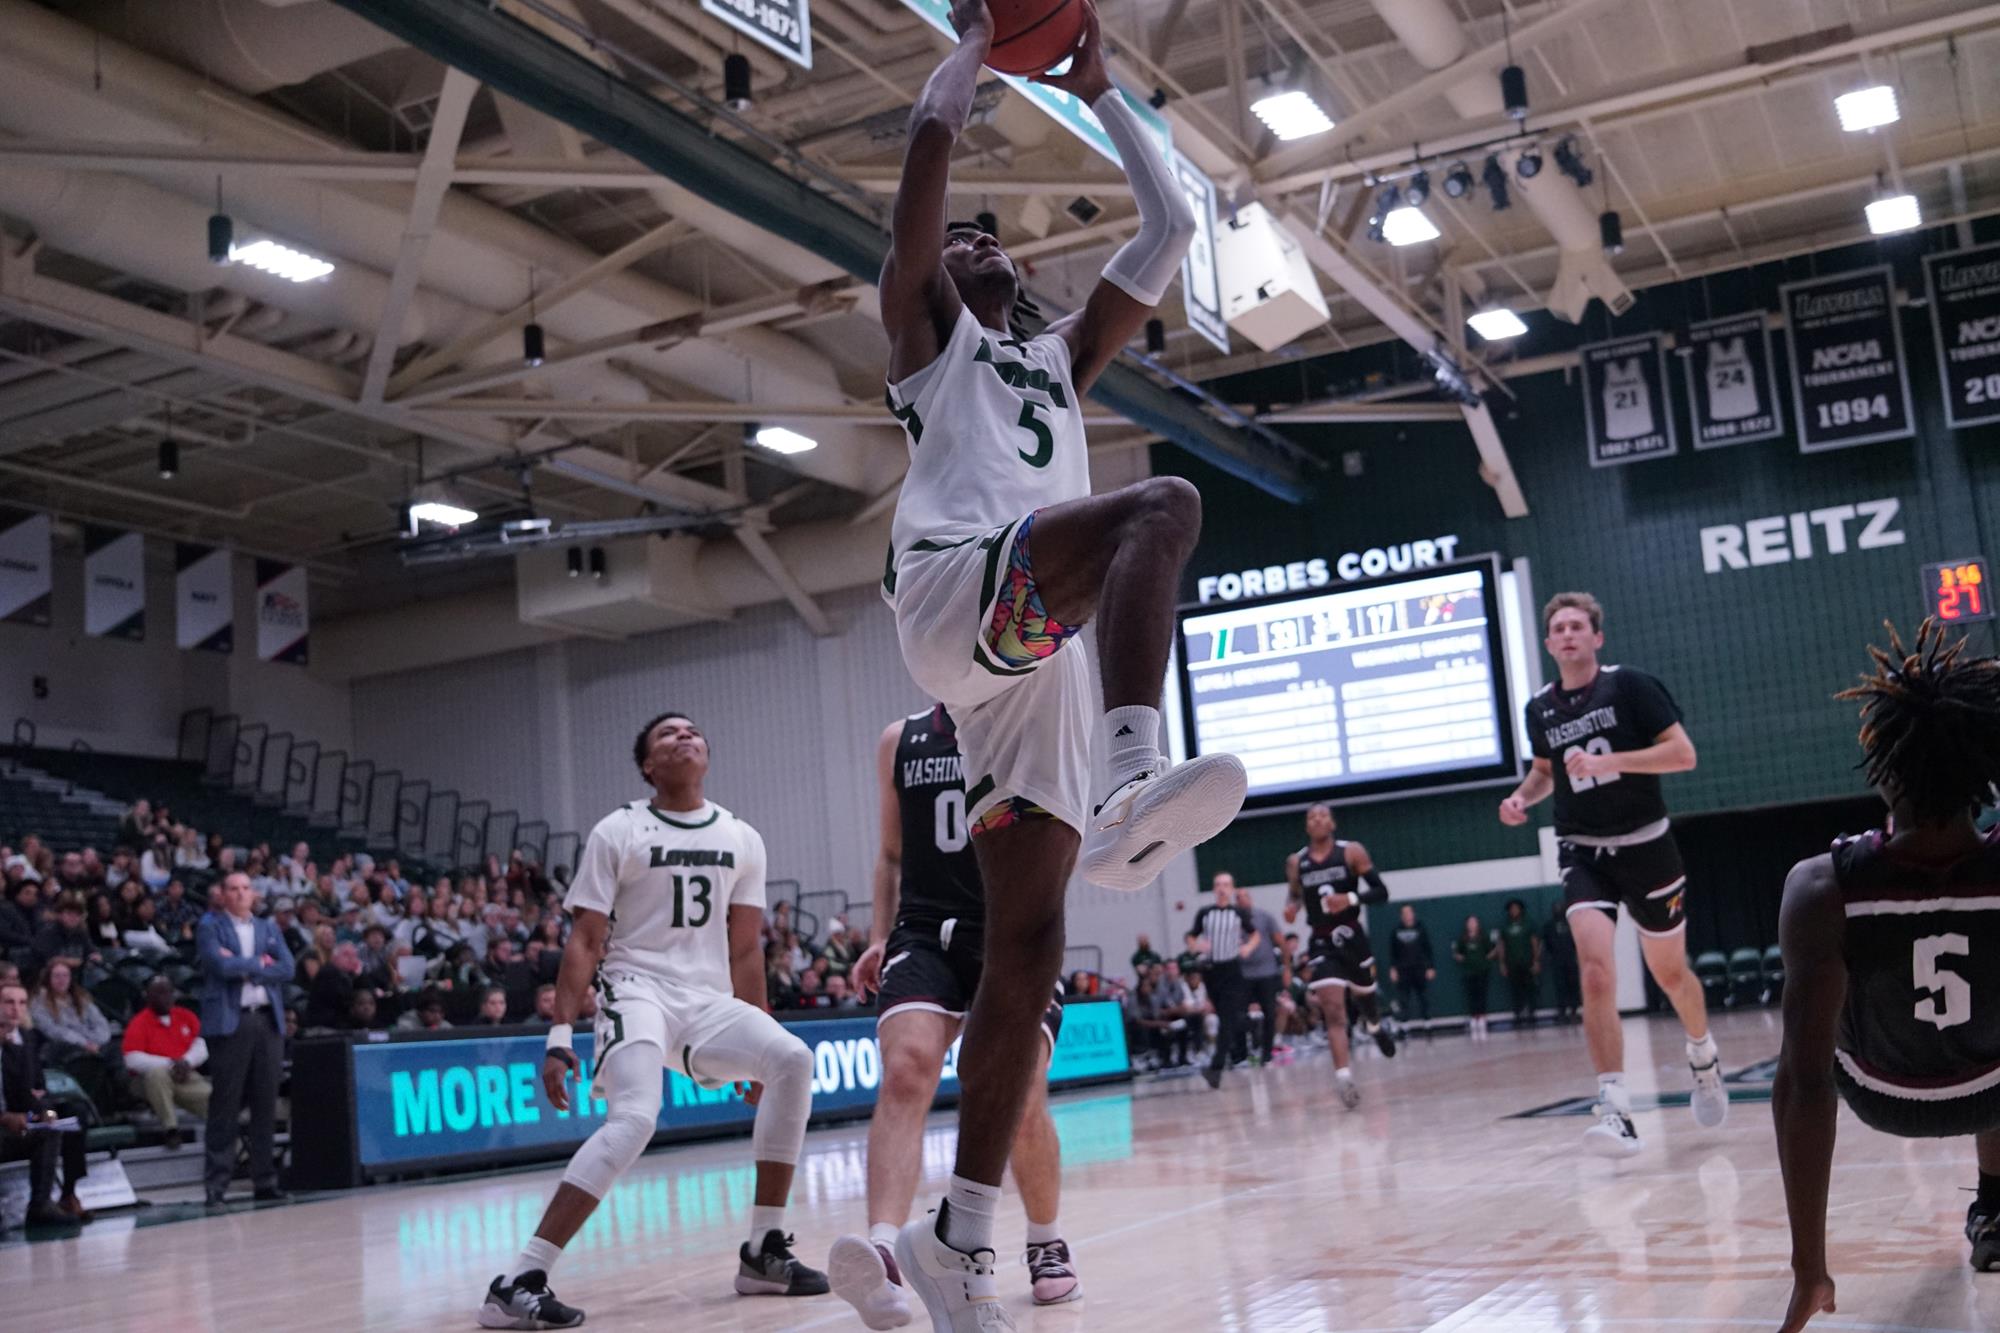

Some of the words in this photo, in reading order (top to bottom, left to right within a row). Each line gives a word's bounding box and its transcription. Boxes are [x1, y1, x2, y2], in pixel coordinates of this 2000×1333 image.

[1812, 338, 1883, 370] NCAA
[1613, 389, 1639, 410] 21
[1715, 369, 1746, 389] 24
[1816, 393, 1890, 429] 1994
[1018, 398, 1054, 469] 5
[1700, 498, 1905, 574] REITZ
[1198, 558, 1330, 604] FORBES
[1337, 534, 1459, 580] COURT
[1937, 584, 1982, 620] 27
[1545, 706, 1618, 749] WASHINGTON
[903, 755, 964, 788] WASHIN
[935, 788, 969, 853] 0
[650, 846, 735, 870] LOYOLA
[670, 874, 712, 929] 13
[1912, 932, 1971, 1031] 5
[391, 1062, 541, 1137] MORE
